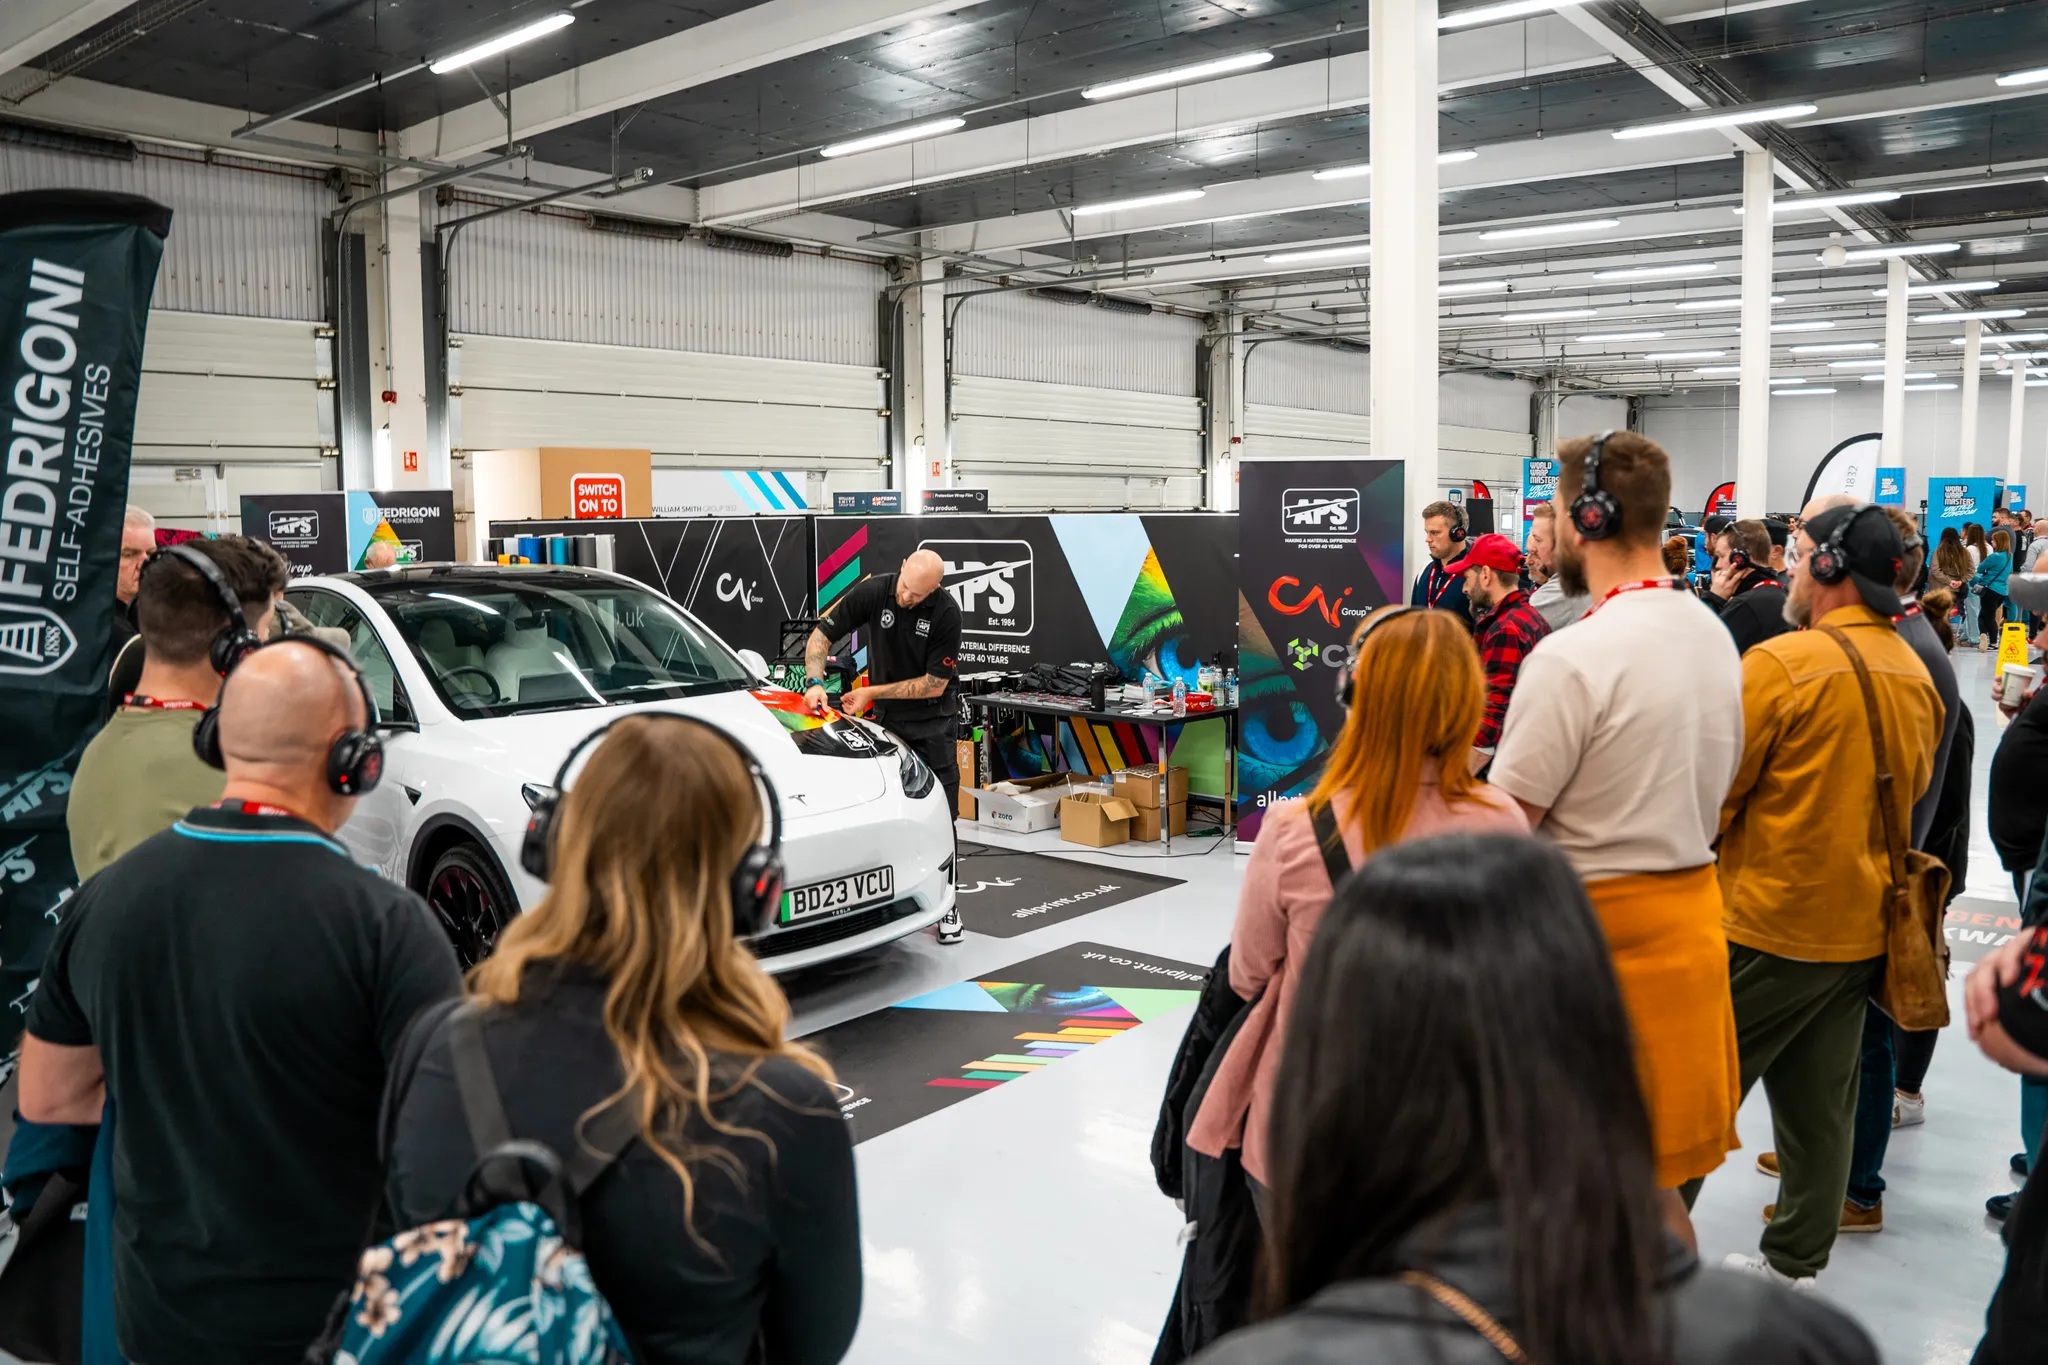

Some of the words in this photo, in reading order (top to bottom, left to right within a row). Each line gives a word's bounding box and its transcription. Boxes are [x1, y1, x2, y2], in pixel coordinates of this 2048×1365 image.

[0, 258, 86, 599] FEDRIGONI
[1529, 461, 1552, 470] WORLD
[53, 364, 111, 602] SELF-ADHESIVES
[1529, 476, 1560, 485] MASTERS
[1845, 465, 1859, 488] 1832
[578, 483, 617, 496] SWITCH
[1944, 485, 1968, 493] WORLD
[579, 498, 599, 513] ON
[601, 498, 618, 513] TO
[1944, 498, 1975, 506] MASTERS
[378, 507, 440, 518] FEDRIGONI
[1293, 498, 1348, 526] APS
[988, 618, 1000, 626] Est.
[1001, 618, 1016, 626] 1984
[45, 625, 61, 657] 1888
[960, 641, 988, 652] ATERIAL
[988, 642, 1030, 654] DIFFERENCE
[958, 652, 976, 662] OVER
[976, 654, 986, 663] 40
[986, 656, 1008, 665] YEARS
[998, 812, 1012, 821] zoro
[793, 880, 848, 915] BD23
[853, 869, 891, 899] VCU
[1012, 884, 1121, 918] allprint.co.uk
[831, 907, 851, 916] TESLA
[1081, 951, 1204, 981] allprint.co.uk
